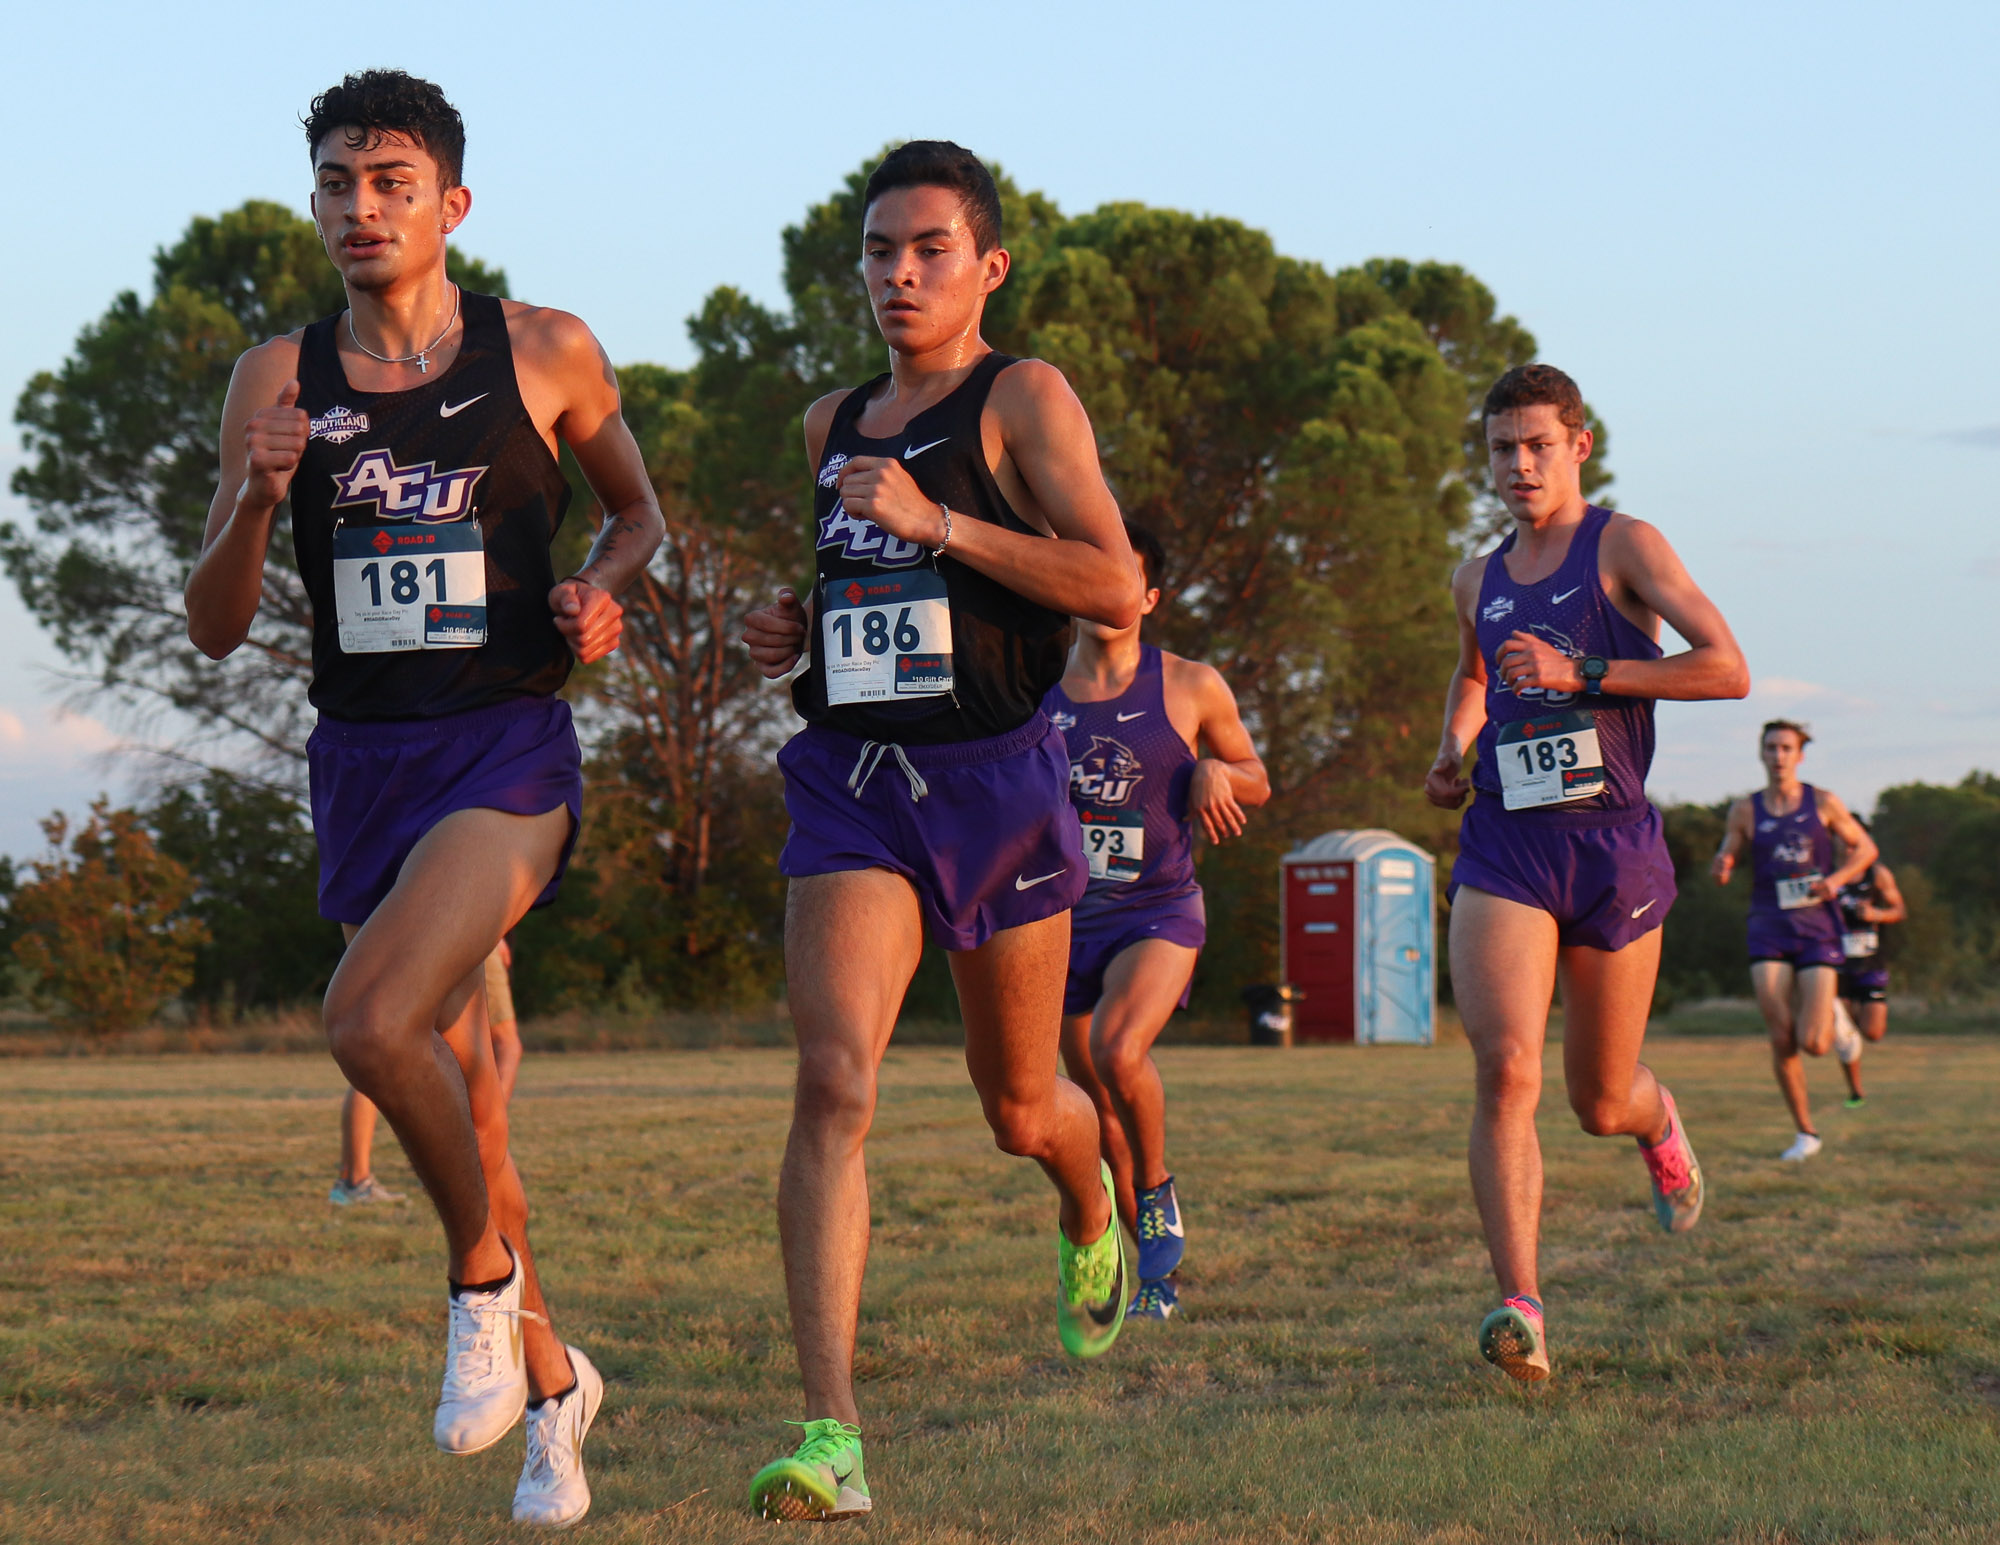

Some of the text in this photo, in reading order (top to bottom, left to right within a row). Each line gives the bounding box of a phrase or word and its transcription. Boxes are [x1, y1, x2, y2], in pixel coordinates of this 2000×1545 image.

[310, 414, 369, 436] SOUTHLAND
[337, 452, 480, 520] ACU
[397, 535, 423, 545] ROAD
[361, 558, 447, 607] 181
[867, 584, 891, 595] ROAD
[442, 626, 454, 634] $10
[832, 606, 921, 658] 186
[912, 675, 924, 683] $10
[1517, 737, 1579, 775] 183
[1069, 763, 1131, 802] ACU
